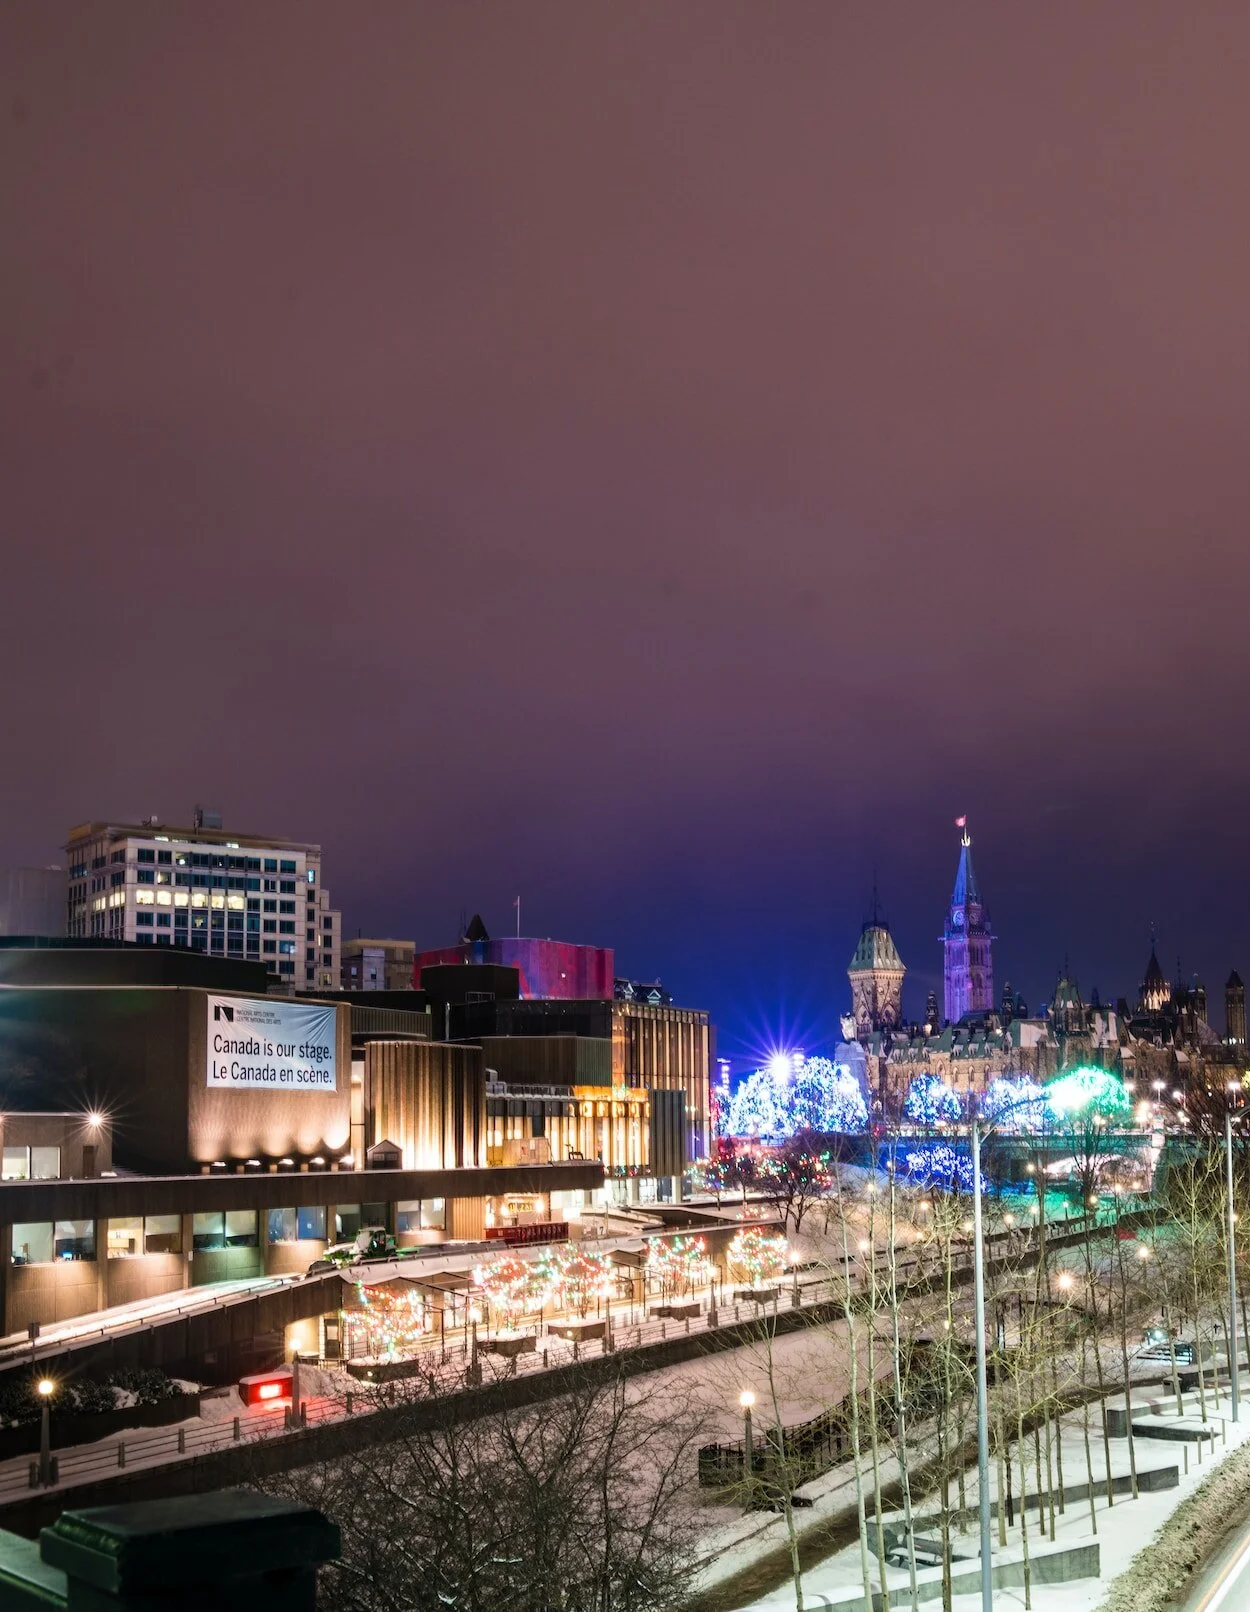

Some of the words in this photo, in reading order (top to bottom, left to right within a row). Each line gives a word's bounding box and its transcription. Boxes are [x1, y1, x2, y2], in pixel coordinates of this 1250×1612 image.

[213, 1034, 260, 1055] Canada
[263, 1038, 273, 1057] is
[276, 1043, 296, 1058] our
[299, 1041, 332, 1063] stage.
[213, 1060, 228, 1079] Le
[231, 1061, 276, 1081] Canada
[280, 1068, 294, 1082] en
[297, 1065, 332, 1083] scène.
